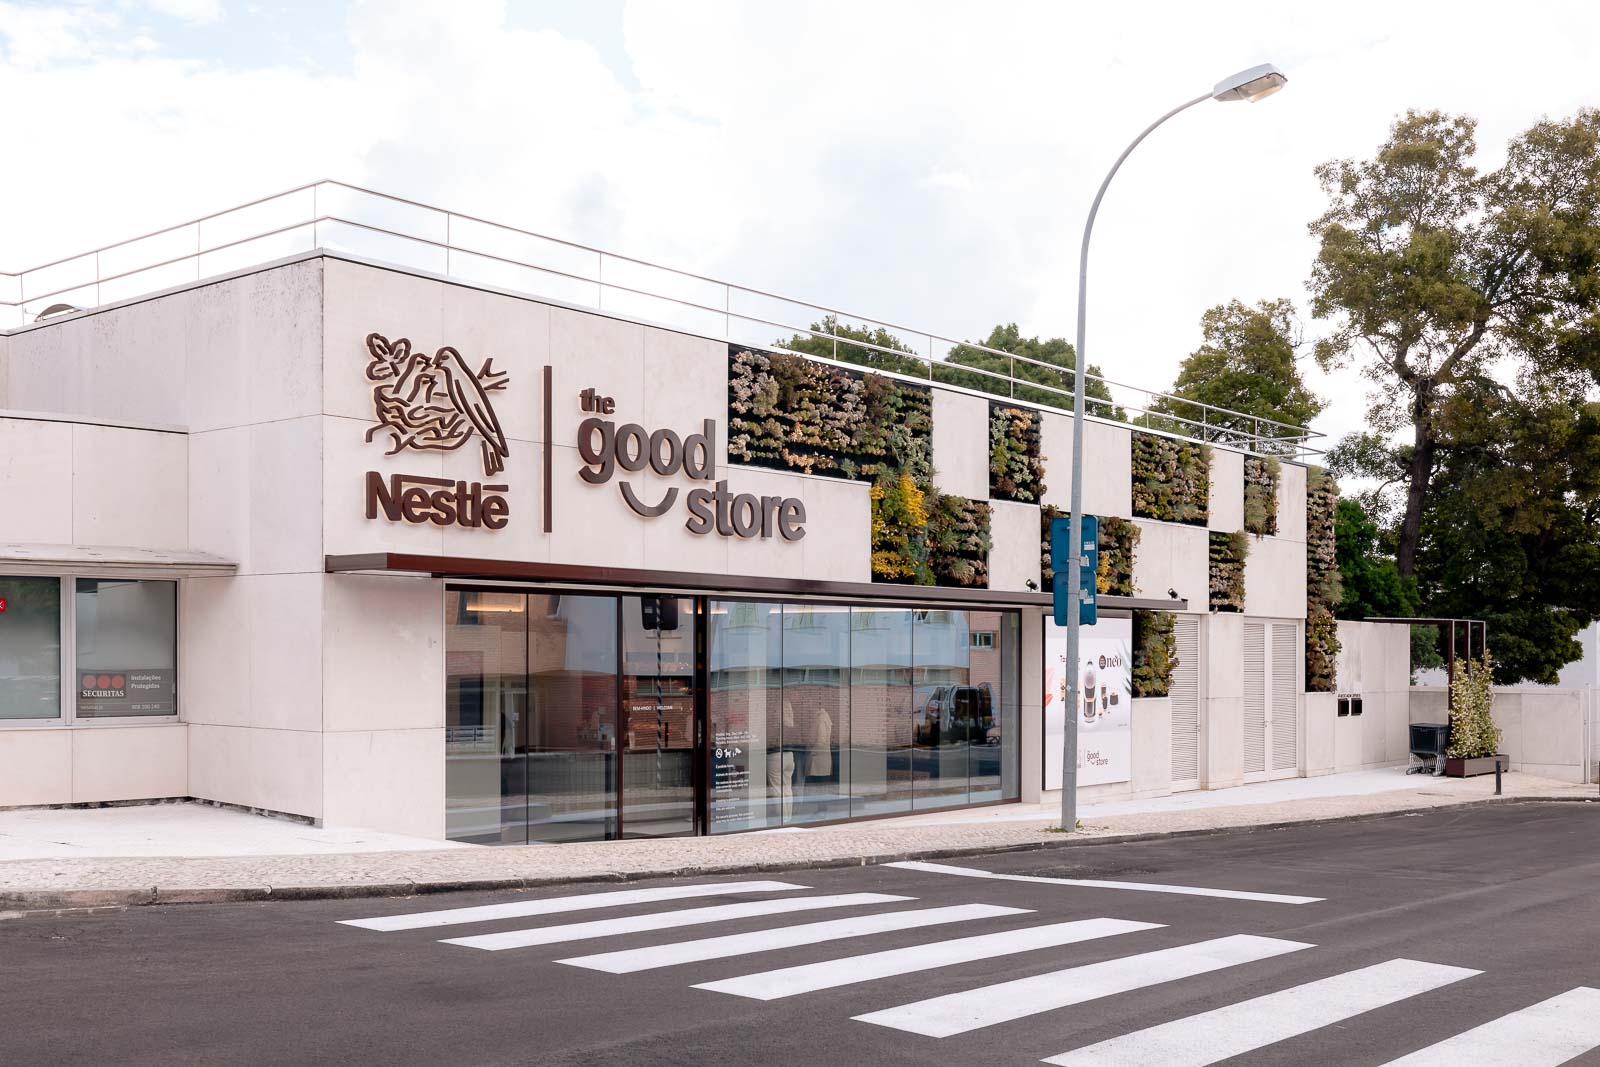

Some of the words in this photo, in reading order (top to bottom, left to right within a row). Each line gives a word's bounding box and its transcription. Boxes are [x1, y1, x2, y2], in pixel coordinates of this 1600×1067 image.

[579, 387, 616, 415] the
[577, 418, 716, 484] good
[685, 479, 807, 542] store
[1096, 758, 1109, 766] store
